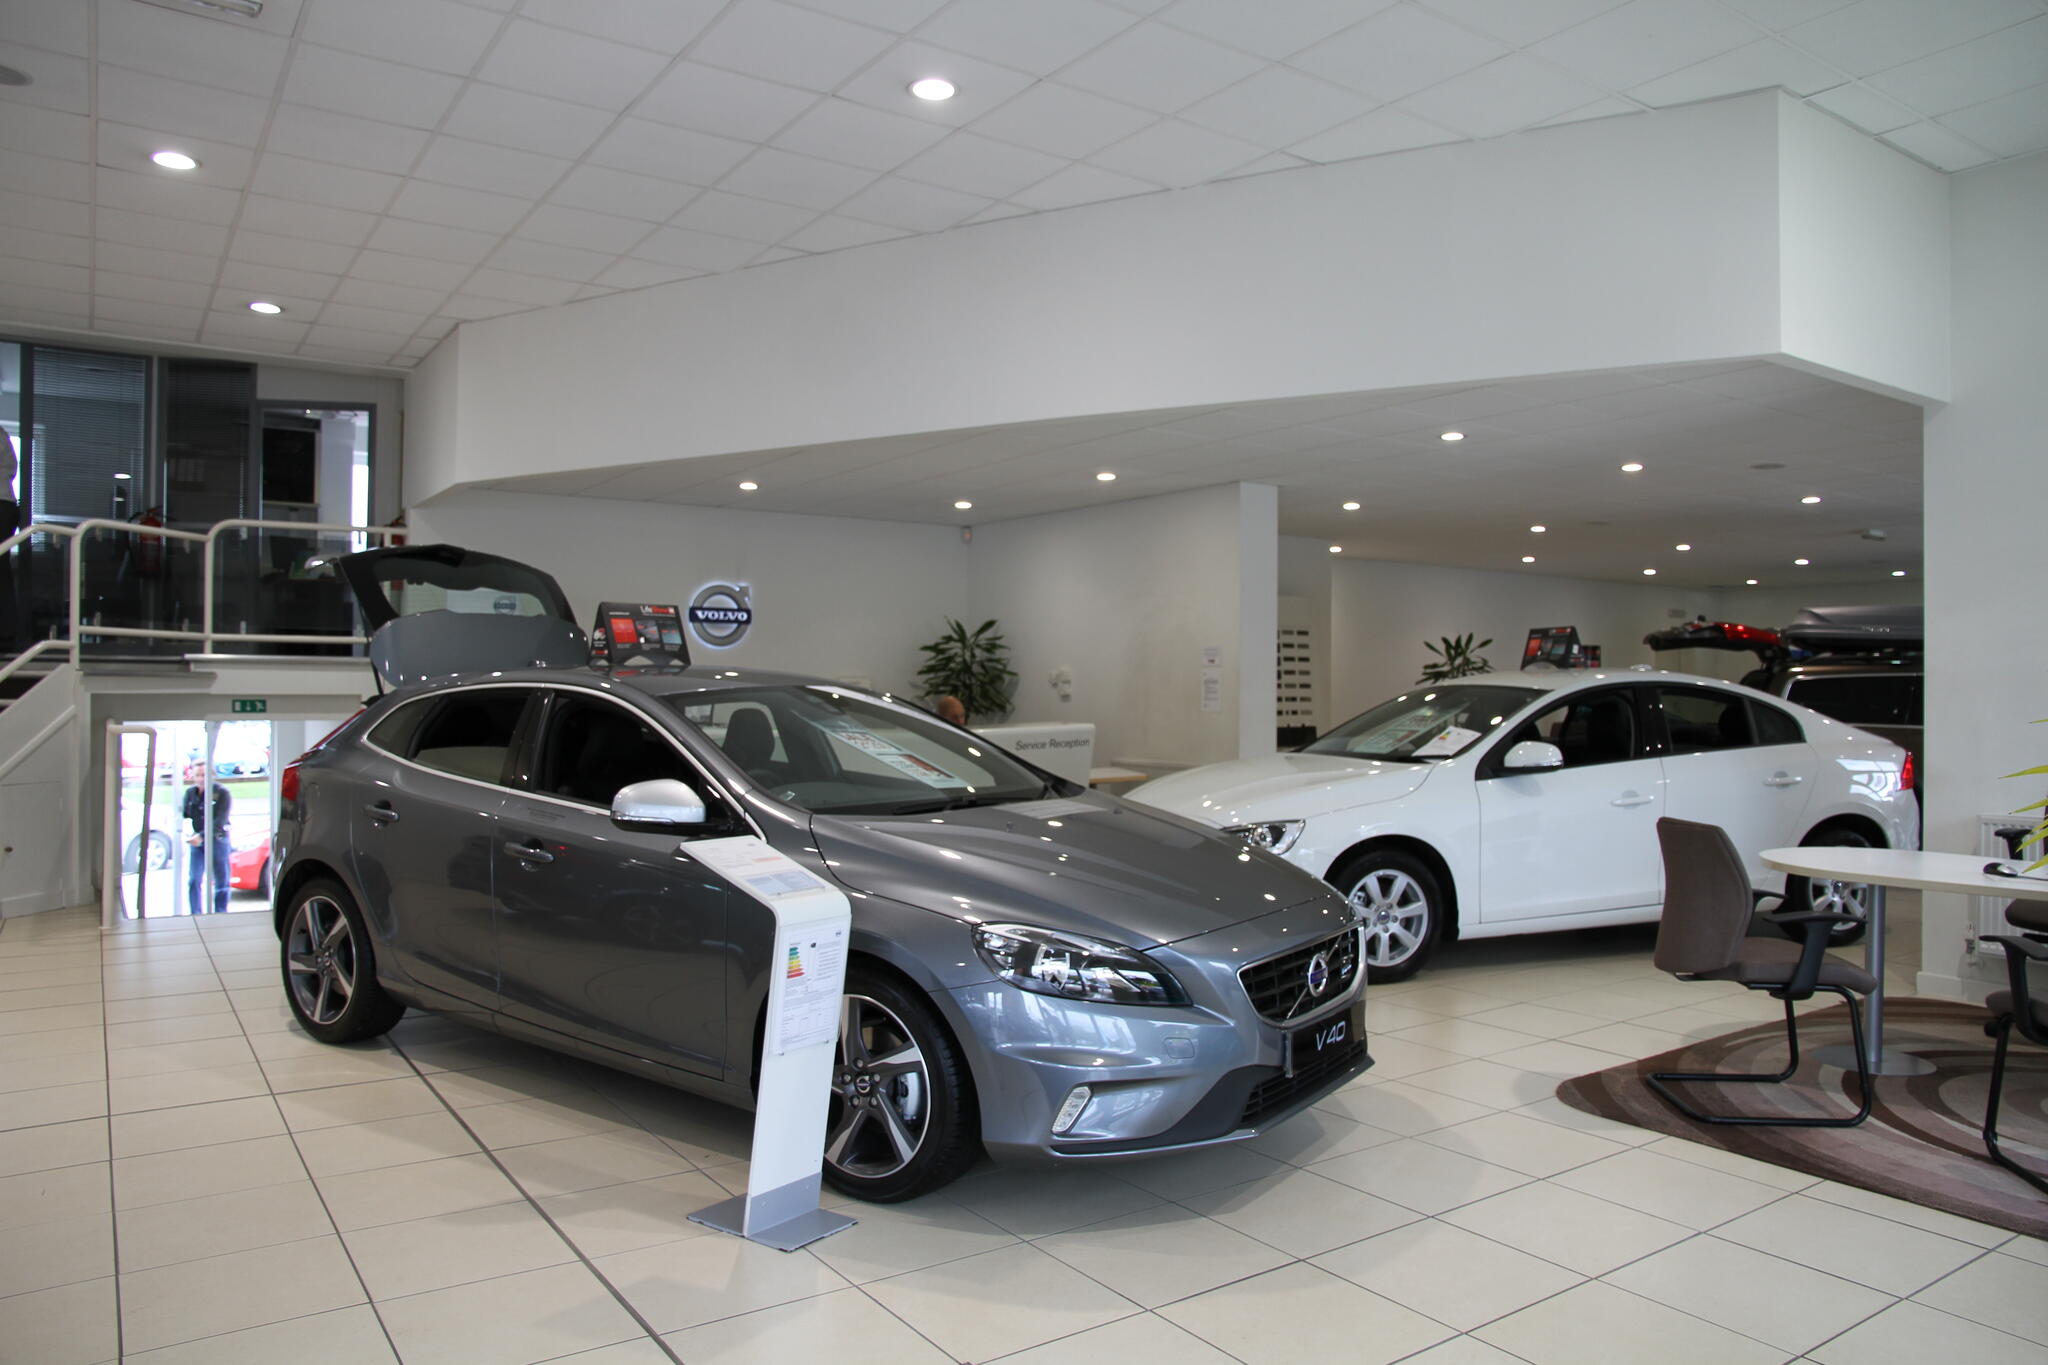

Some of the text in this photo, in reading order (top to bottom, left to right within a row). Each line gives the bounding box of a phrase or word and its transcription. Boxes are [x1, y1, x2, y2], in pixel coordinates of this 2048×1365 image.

[695, 610, 748, 621] VOLVO
[1015, 738, 1090, 751] Service Reception
[1316, 1021, 1346, 1051] V40
